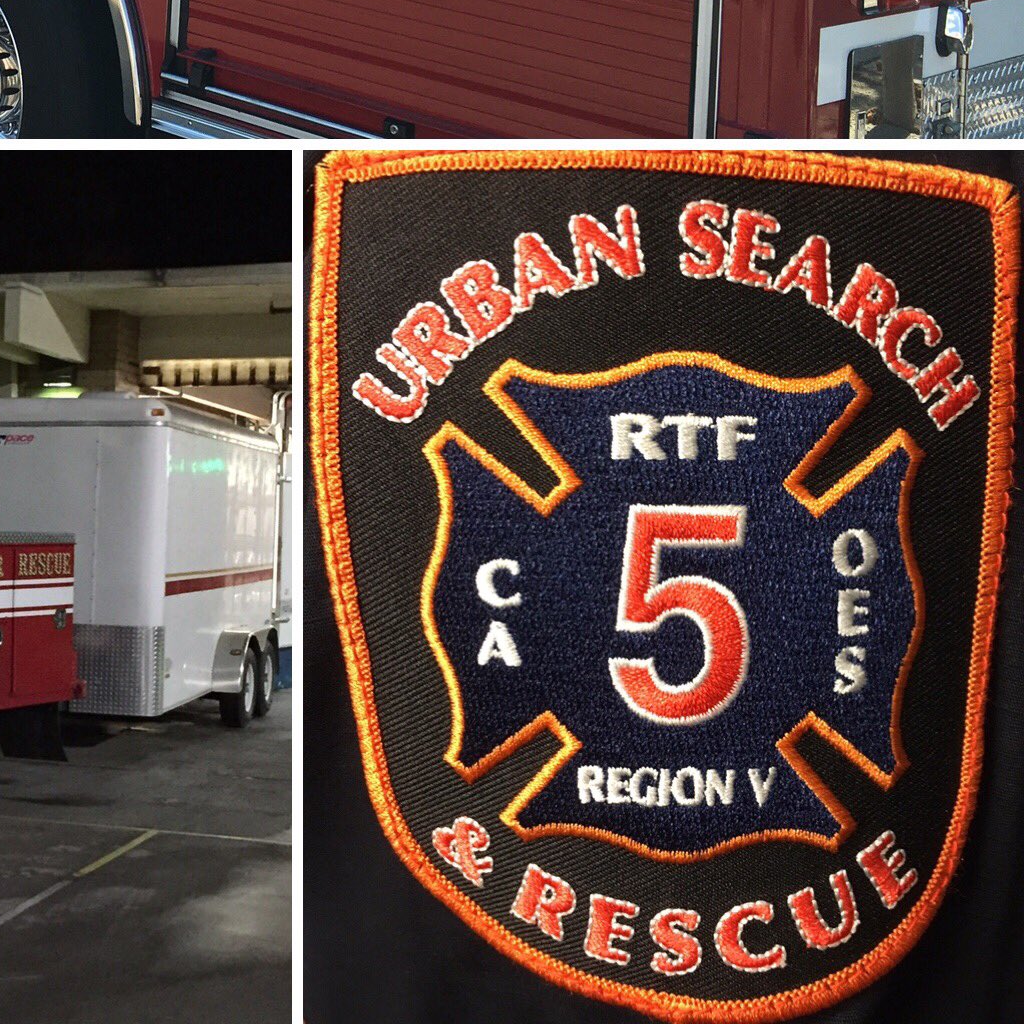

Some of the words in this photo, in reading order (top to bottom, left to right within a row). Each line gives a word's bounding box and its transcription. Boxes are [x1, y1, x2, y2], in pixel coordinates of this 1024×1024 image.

[352, 204, 646, 424] URBAN
[678, 199, 981, 431] SEARCH
[609, 412, 758, 461] RTF
[18, 552, 72, 576] RESCUE
[608, 503, 750, 725] 5
[832, 527, 878, 695] OES
[576, 765, 735, 807] REGION
[744, 766, 777, 807] V
[431, 816, 494, 887] &
[509, 829, 919, 977] RESCUE
